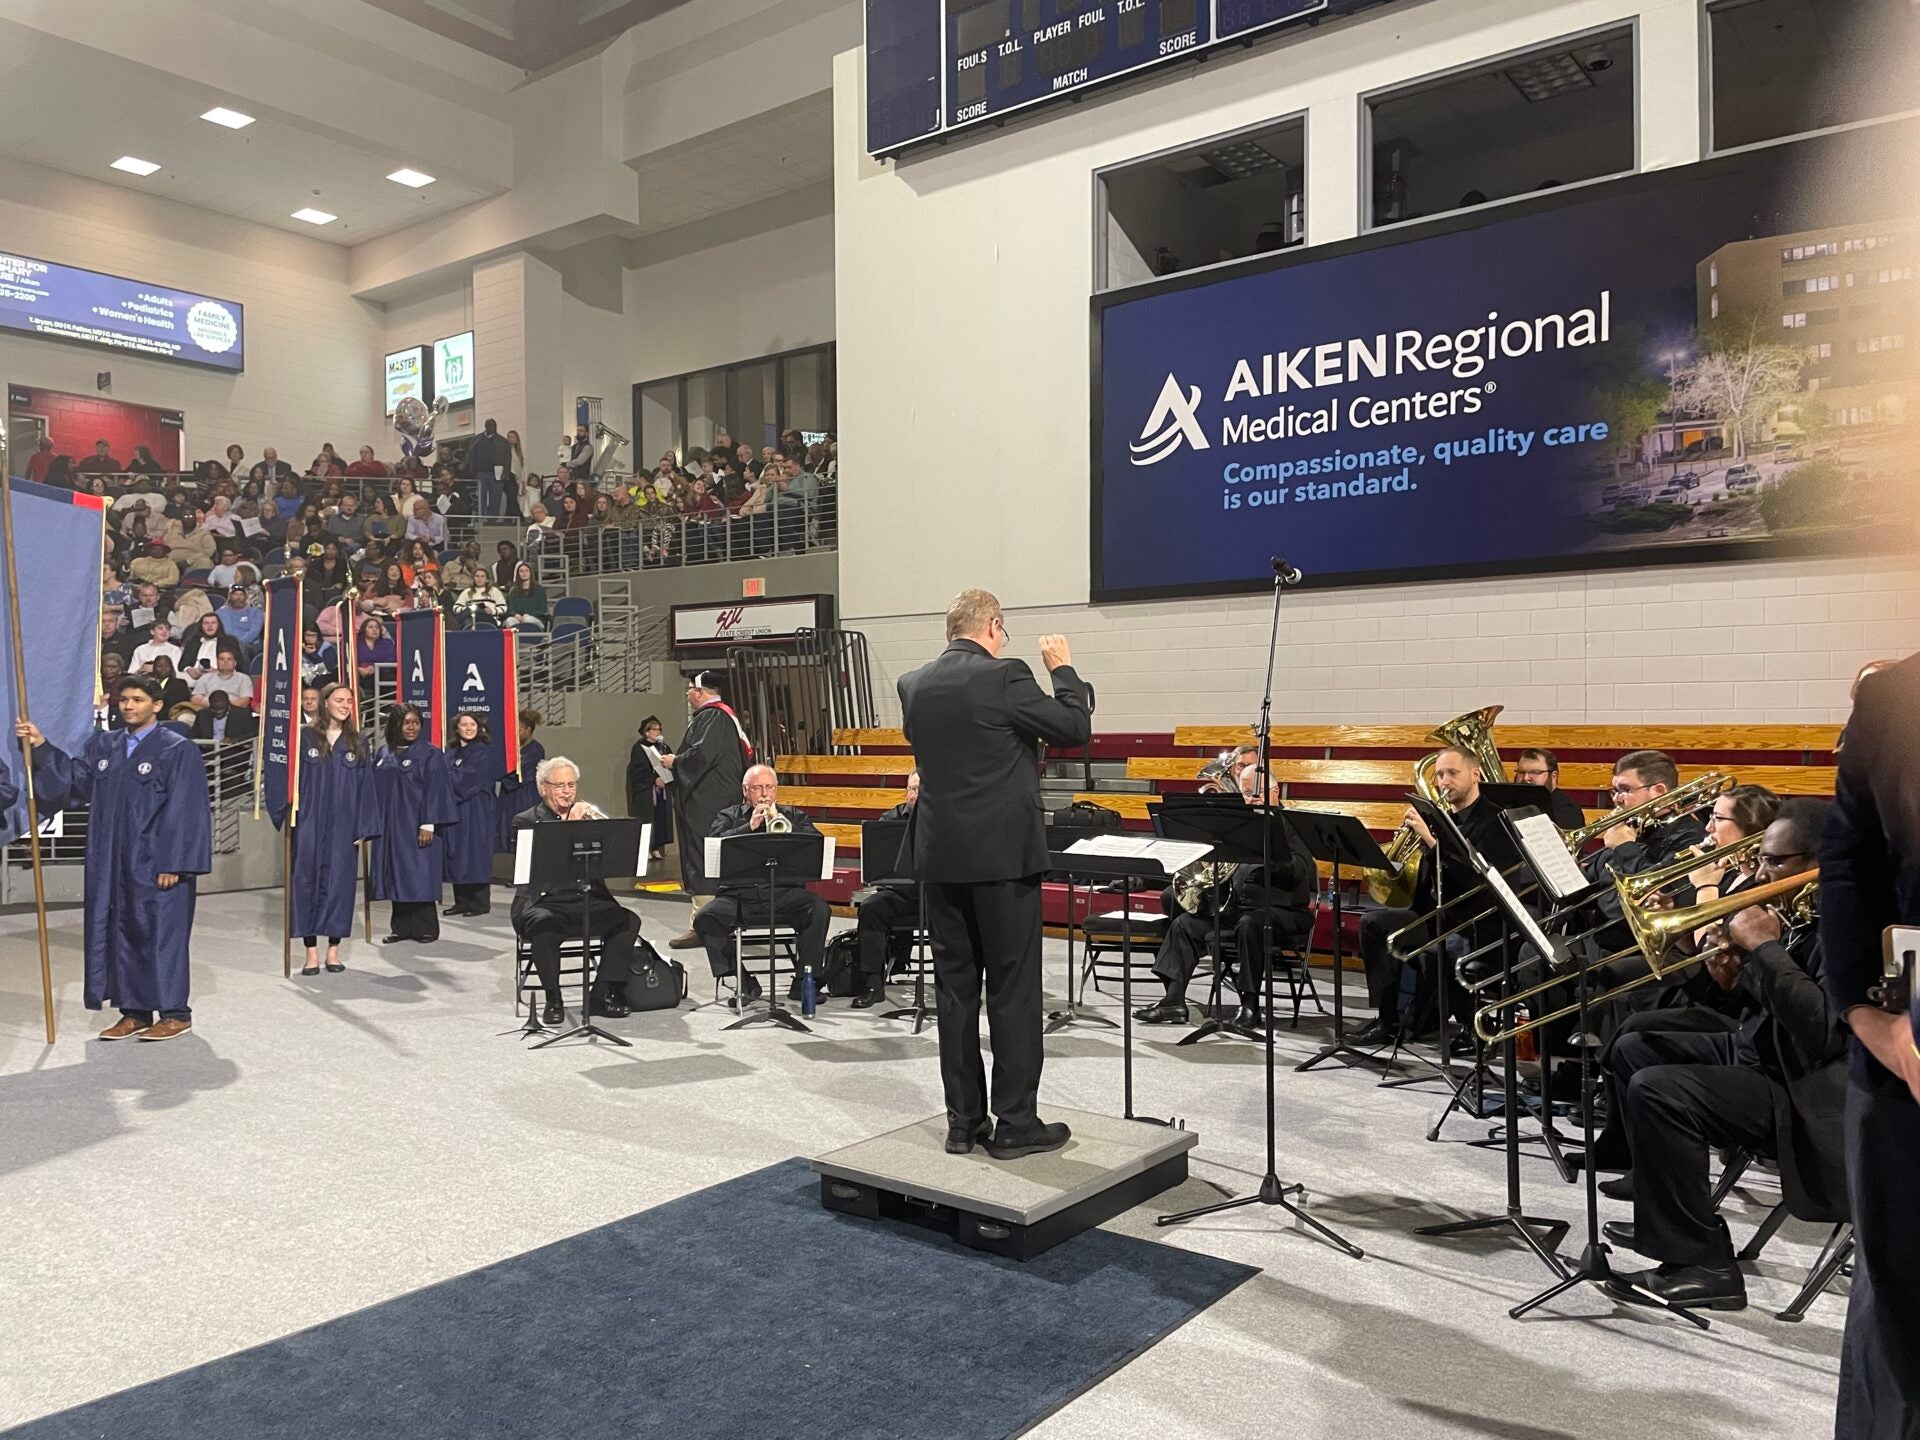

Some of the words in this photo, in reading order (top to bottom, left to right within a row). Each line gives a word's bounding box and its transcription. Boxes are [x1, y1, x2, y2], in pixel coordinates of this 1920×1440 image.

[1033, 20, 1071, 45] PLAYER
[1078, 8, 1106, 29] FOUL
[998, 39, 1024, 57] T.O.L.
[1159, 31, 1197, 55] SCORE
[957, 50, 988, 72] FOULS
[1053, 68, 1088, 90] MATCH
[956, 101, 988, 122] SCORE
[127, 301, 175, 318] Pediatrics
[143, 293, 174, 307] Adults
[98, 306, 143, 323] Women's
[143, 316, 175, 330] Health
[193, 316, 231, 330] MEDICINE
[197, 309, 226, 321] FAMILY
[1223, 334, 1388, 402] AIKEN
[1395, 290, 1611, 378] Regional
[1222, 396, 1338, 446] Medical
[1223, 444, 1426, 486] Compassionate,
[1433, 426, 1535, 466] quality
[1543, 421, 1609, 447] care
[1222, 489, 1242, 510] is
[1247, 485, 1289, 507] our
[1294, 467, 1418, 503] standard.
[719, 629, 735, 637] STATE
[736, 629, 754, 637] CREDIT
[755, 627, 772, 635] UNION
[462, 663, 485, 691] A
